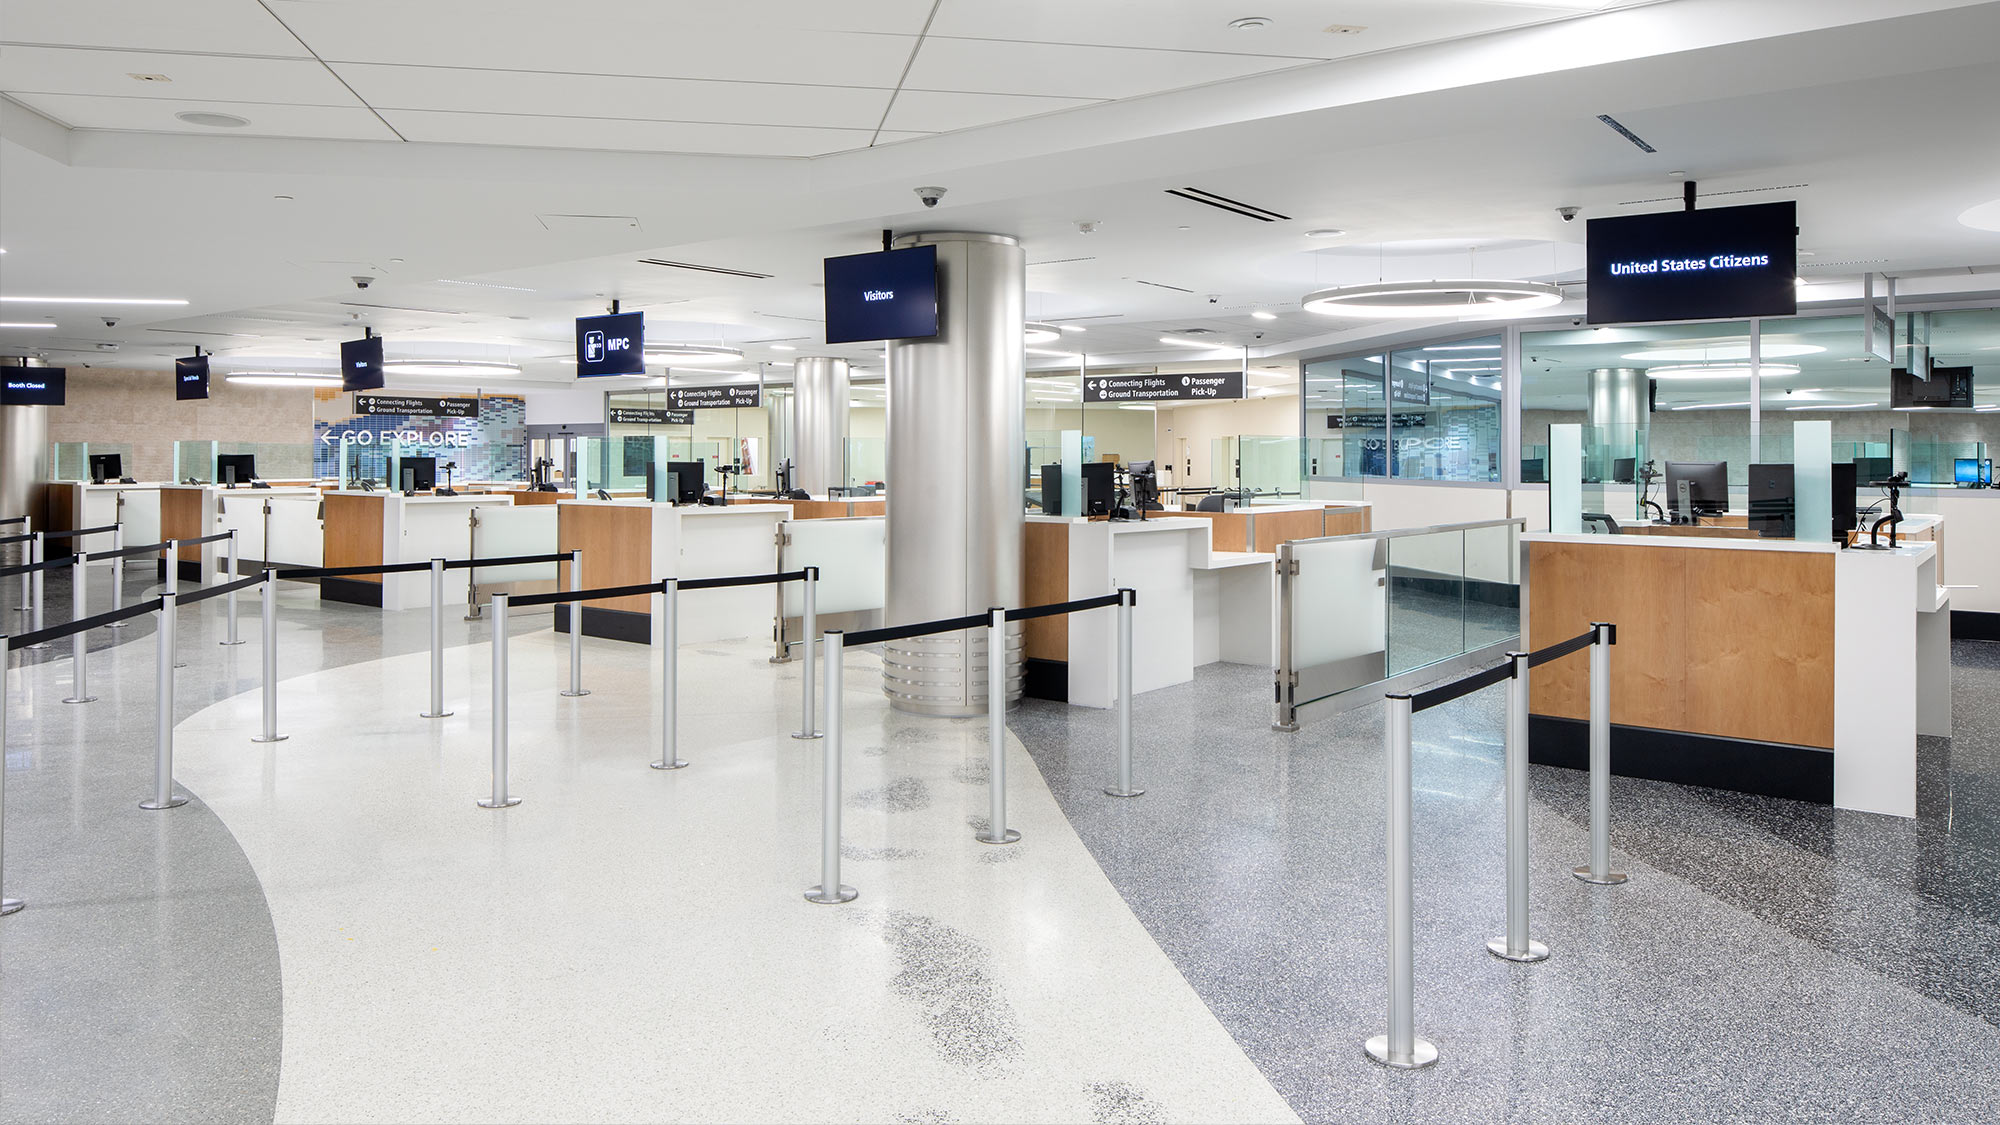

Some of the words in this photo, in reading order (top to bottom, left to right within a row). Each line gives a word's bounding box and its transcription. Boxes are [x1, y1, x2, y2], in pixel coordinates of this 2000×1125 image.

[1610, 260, 1658, 275] United
[1661, 258, 1706, 272] States
[1709, 254, 1768, 269] Citizens
[863, 290, 894, 302] Visitors
[607, 337, 630, 351] MPC
[1108, 380, 1143, 389] Connecting
[1144, 378, 1166, 388] Flights
[1191, 377, 1225, 388] Passenger
[683, 390, 707, 399] Connecting
[707, 388, 722, 398] Flights
[735, 388, 758, 398] Passenger
[1108, 390, 1131, 398] Ground
[1133, 388, 1179, 398] Transportation
[1191, 387, 1217, 397] Pick-Up
[376, 399, 405, 407] Connecting
[446, 401, 471, 410] Passenger
[683, 399, 699, 407] Ground
[699, 398, 731, 407] Transportation
[735, 397, 753, 406] Pick-Up
[396, 407, 433, 415] Transportation
[341, 429, 373, 446] GO
[381, 430, 469, 447] EXPLORE
